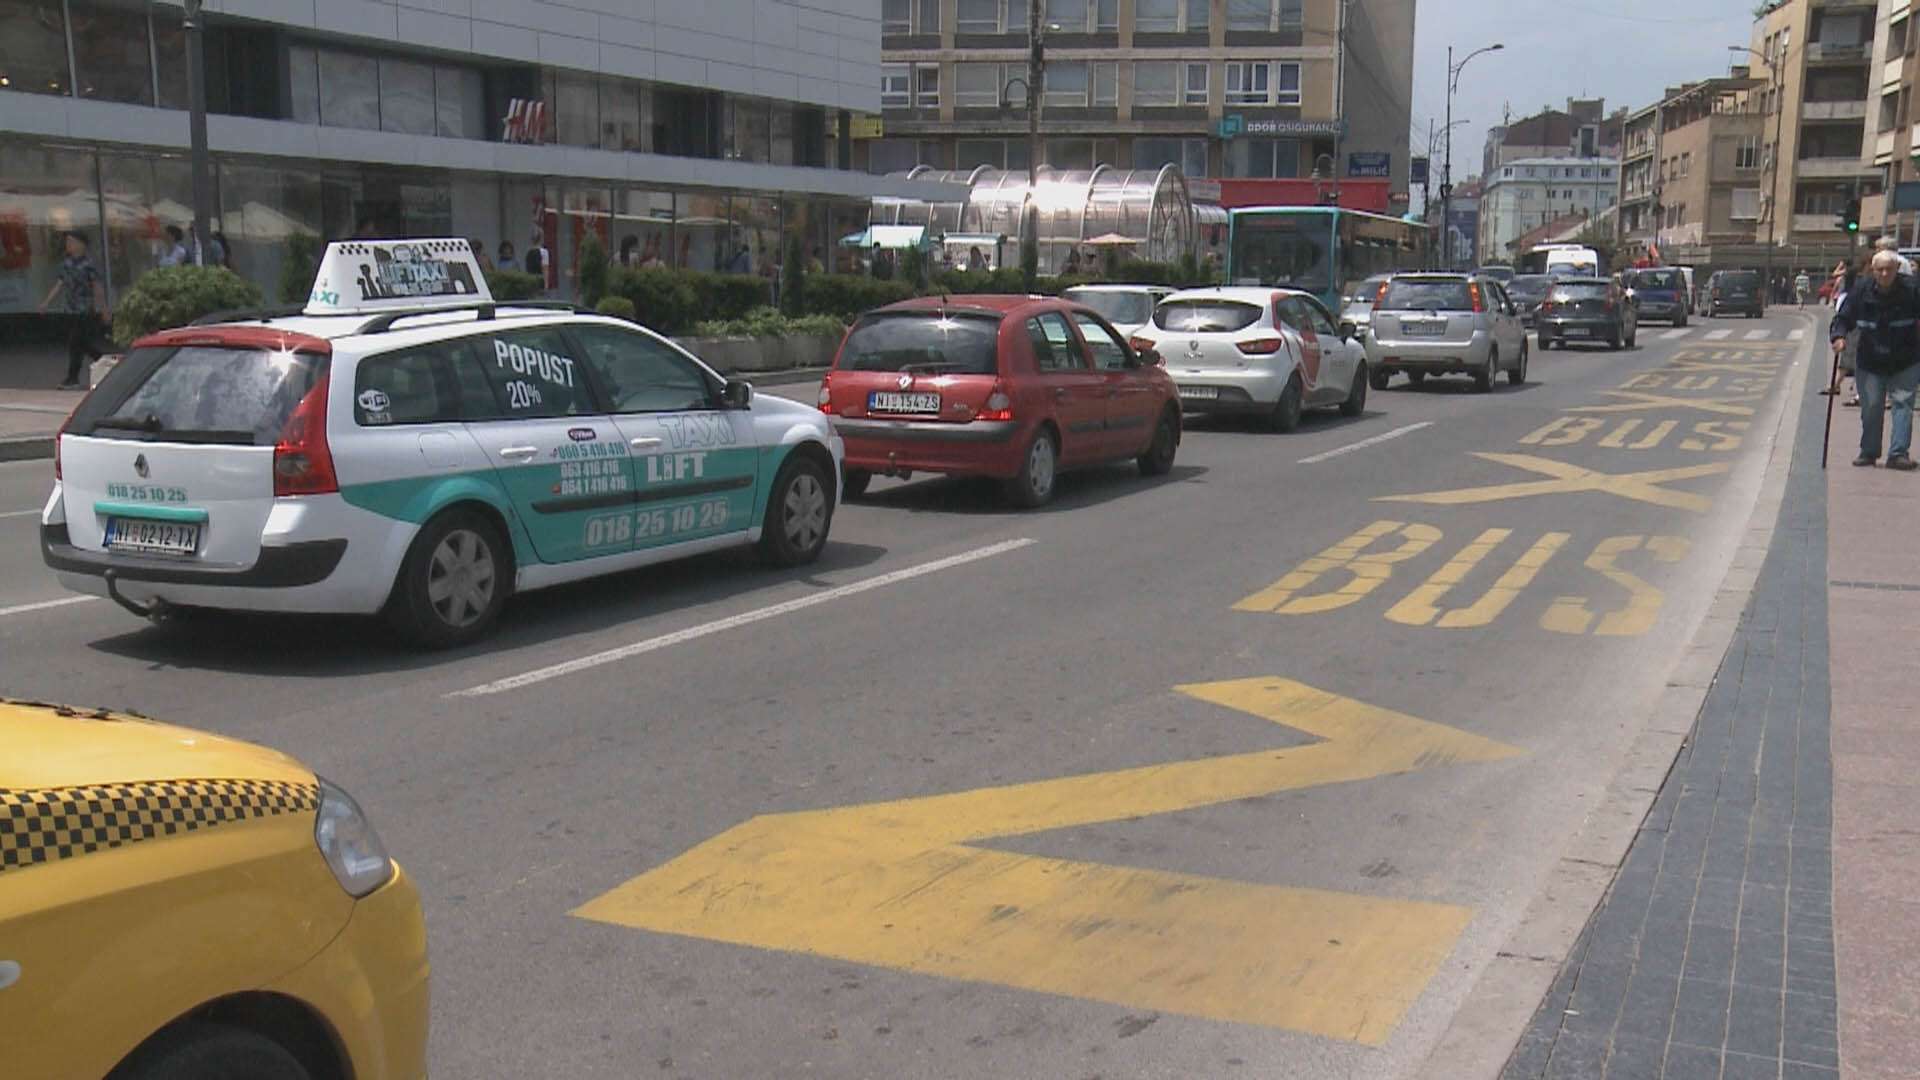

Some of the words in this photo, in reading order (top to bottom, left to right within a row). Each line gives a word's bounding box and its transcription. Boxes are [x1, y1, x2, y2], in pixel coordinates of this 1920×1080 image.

[493, 339, 574, 388] POPUST
[506, 381, 542, 409] 20%
[1617, 373, 1776, 392] BUS
[658, 414, 736, 448] TAXI
[1517, 414, 1751, 451] BUS
[648, 453, 704, 481] LIFT
[130, 485, 147, 499] 25
[149, 487, 165, 501] 10
[167, 487, 187, 502] 25
[587, 515, 631, 546] 018
[636, 511, 665, 538] 25
[670, 506, 695, 532] 10
[700, 500, 728, 527] 25
[1230, 520, 1691, 636] BUS
